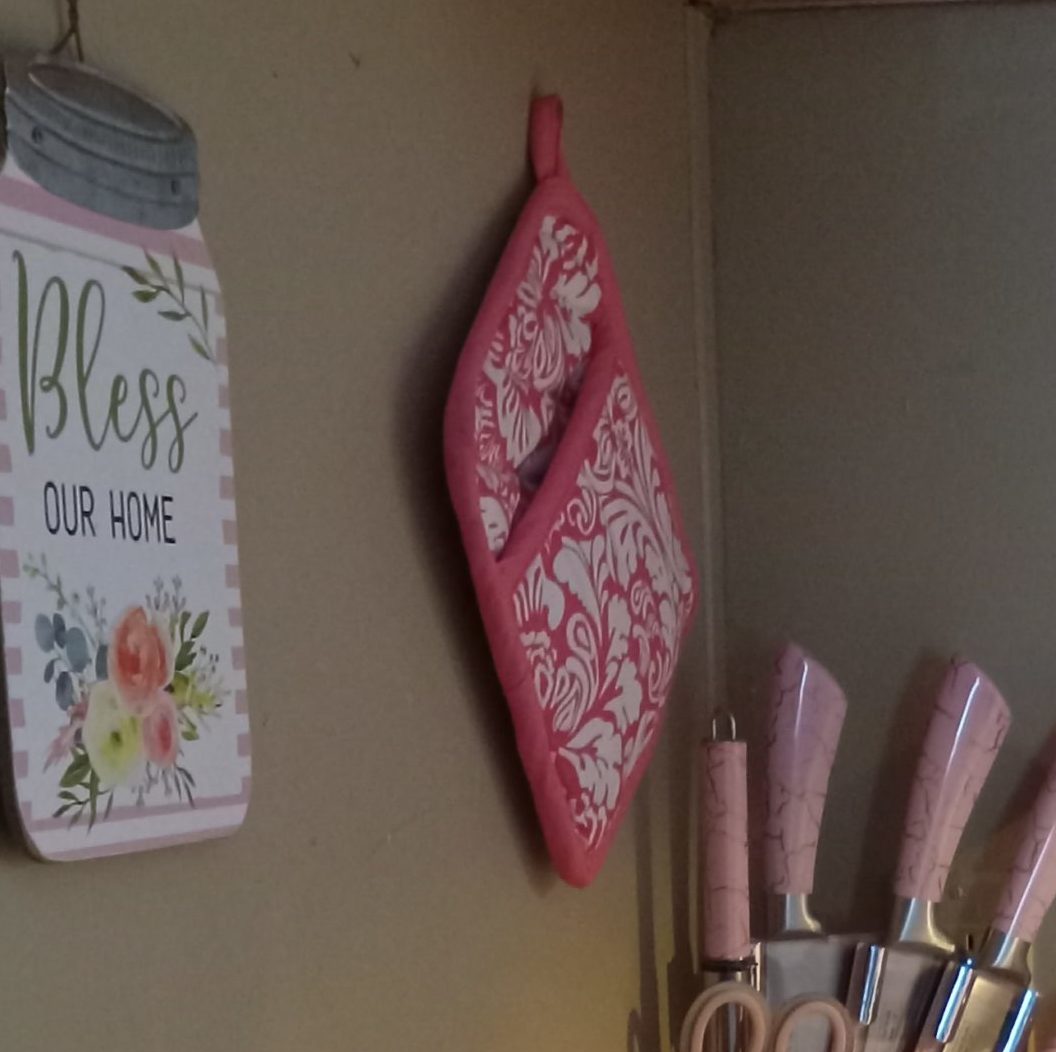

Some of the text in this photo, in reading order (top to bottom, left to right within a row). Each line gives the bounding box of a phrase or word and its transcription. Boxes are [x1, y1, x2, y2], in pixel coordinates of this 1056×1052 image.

[12, 249, 199, 474] Bless
[43, 481, 176, 545] OUR HOME
